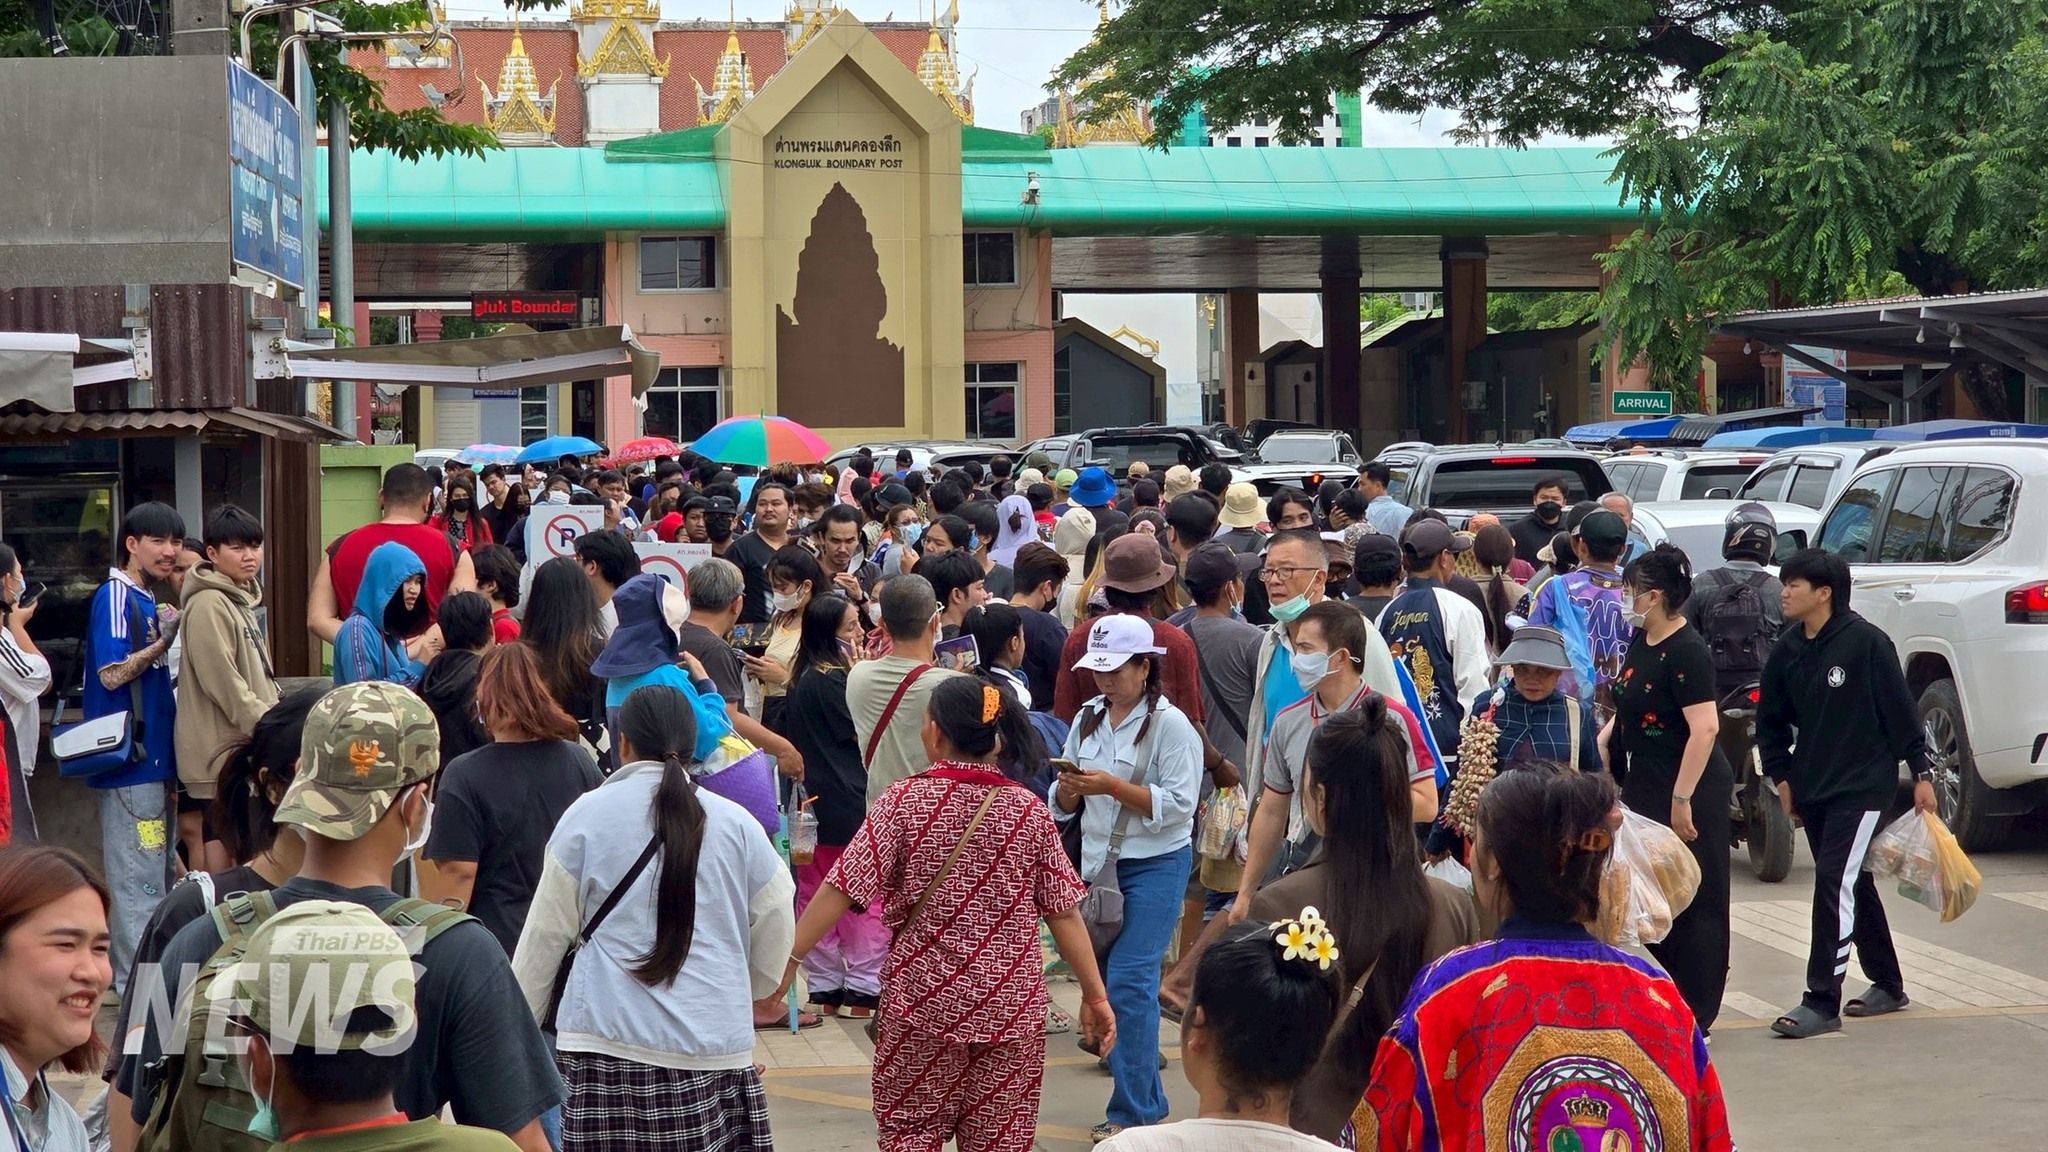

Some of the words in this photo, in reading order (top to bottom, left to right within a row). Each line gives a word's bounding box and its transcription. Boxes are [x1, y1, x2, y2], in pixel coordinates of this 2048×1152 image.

[775, 134, 901, 153] ด่านพรมแดนคลองลึก
[774, 159, 822, 168] KLONGLUK
[826, 159, 876, 168] BOUNDARY
[880, 158, 903, 168] POST
[1617, 398, 1667, 409] ARRIVAL
[1390, 609, 1430, 635] Japan
